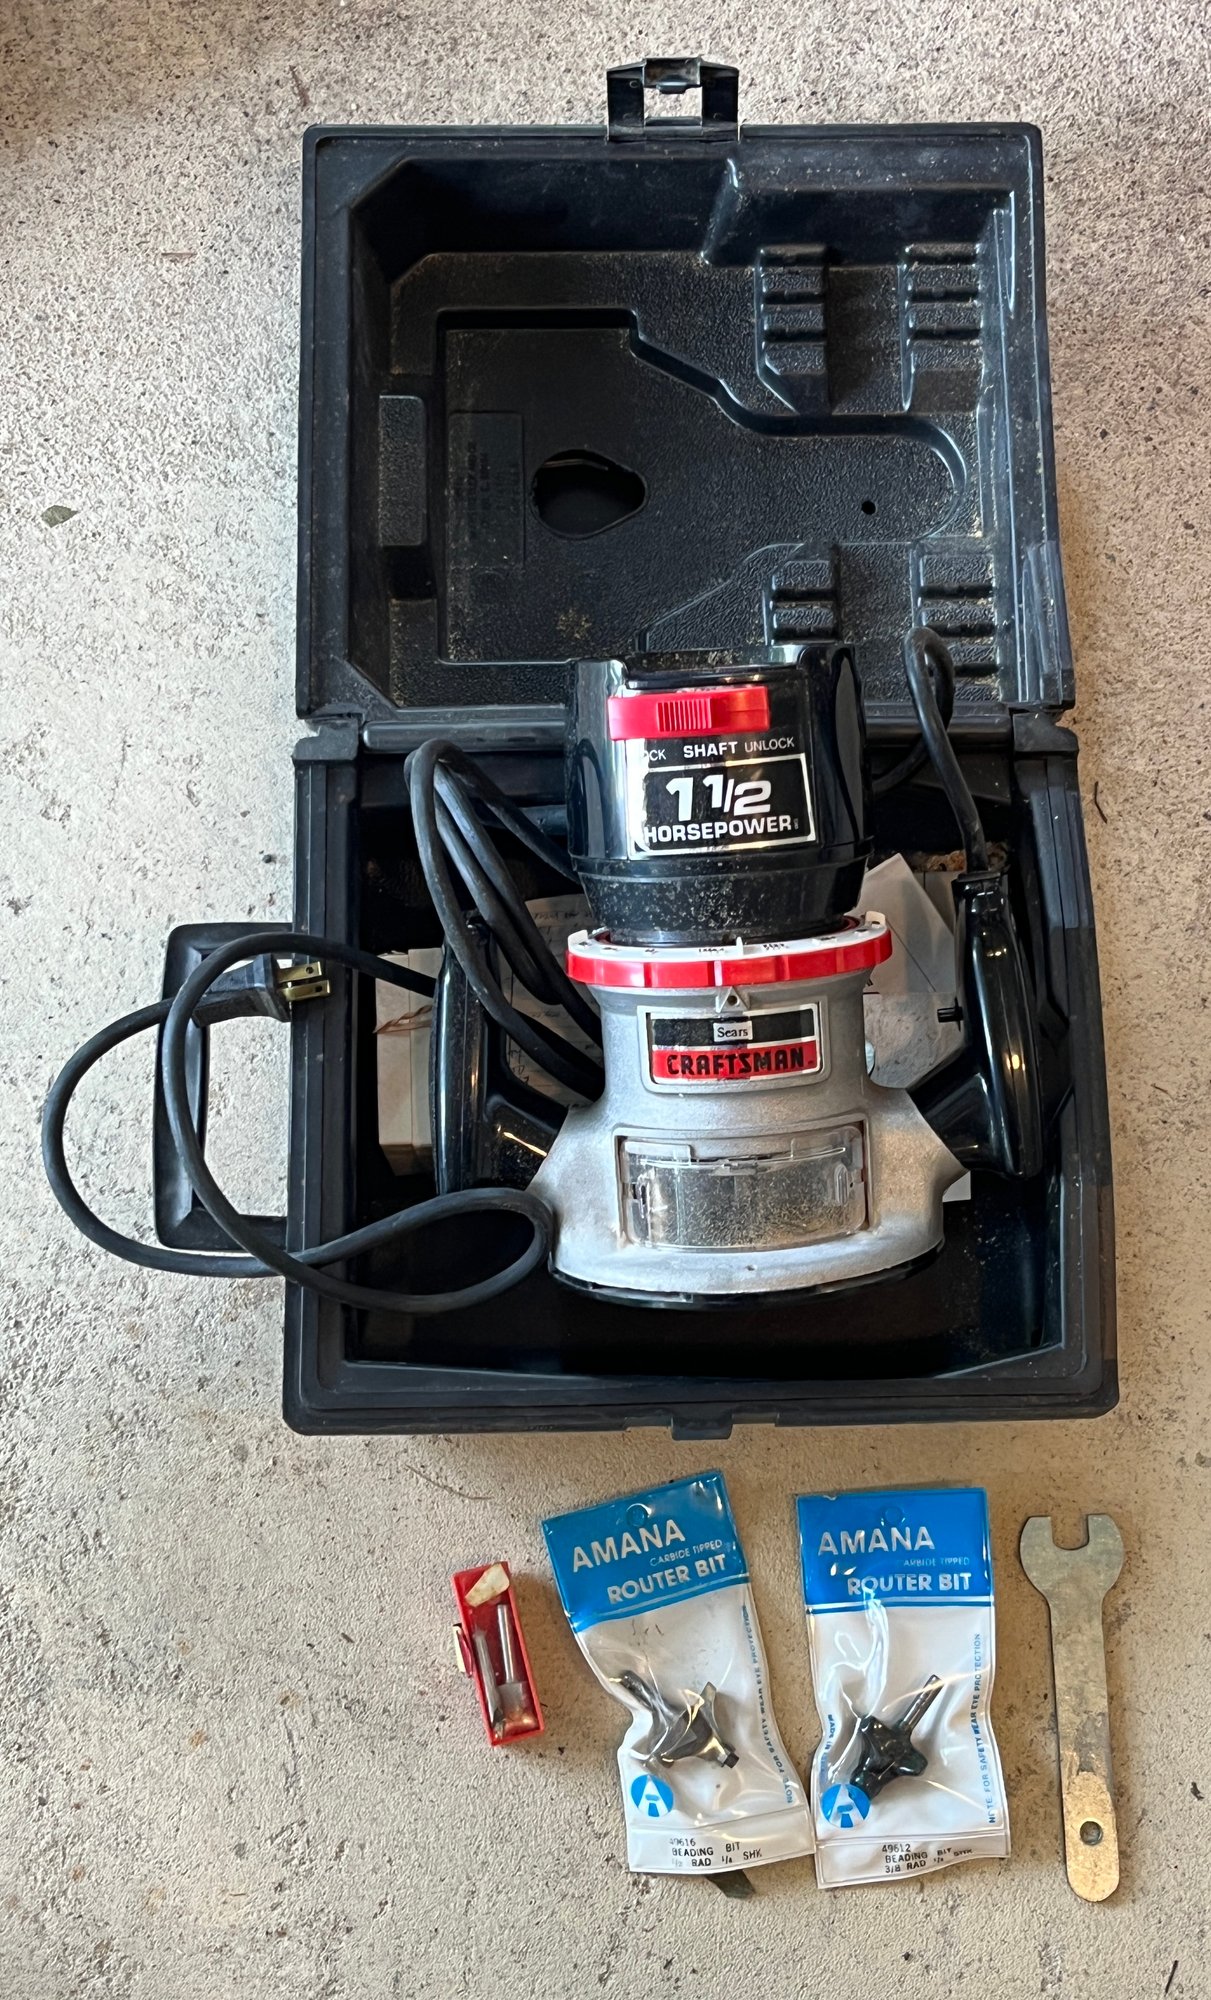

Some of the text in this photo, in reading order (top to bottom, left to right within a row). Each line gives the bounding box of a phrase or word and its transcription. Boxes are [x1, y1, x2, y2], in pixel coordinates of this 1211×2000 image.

[642, 736, 795, 761] OCK SHAFT UNLOCK
[665, 774, 772, 822] 1 1/2
[644, 814, 792, 844] HORSEPOWER
[717, 1026, 749, 1038] Sears
[666, 1046, 805, 1076] CRAFTSMAN
[572, 1518, 687, 1573] AMANA
[649, 1539, 723, 1567] CARBIDE TIPPED
[817, 1525, 936, 1557] AMANA
[898, 1557, 936, 1567] ARBIDE
[606, 1553, 727, 1605] ROUTER BIT
[847, 1572, 972, 1597] ROUTER BIT
[973, 1633, 982, 1692] PROTECTION
[970, 1694, 980, 1710] EYE
[761, 1718, 775, 1753] SAFETY
[970, 1711, 981, 1735] WEAR
[773, 1755, 785, 1774] FOR
[975, 1736, 988, 1772] SAFETY
[981, 1773, 991, 1793] FOR
[671, 1841, 741, 1858] BEADING BIT
[881, 1843, 911, 1853] 49612
[885, 1851, 928, 1864] BEADING
[691, 1857, 712, 1867] RAD
[885, 1863, 901, 1874] 3/8
[906, 1859, 927, 1871] RAD
